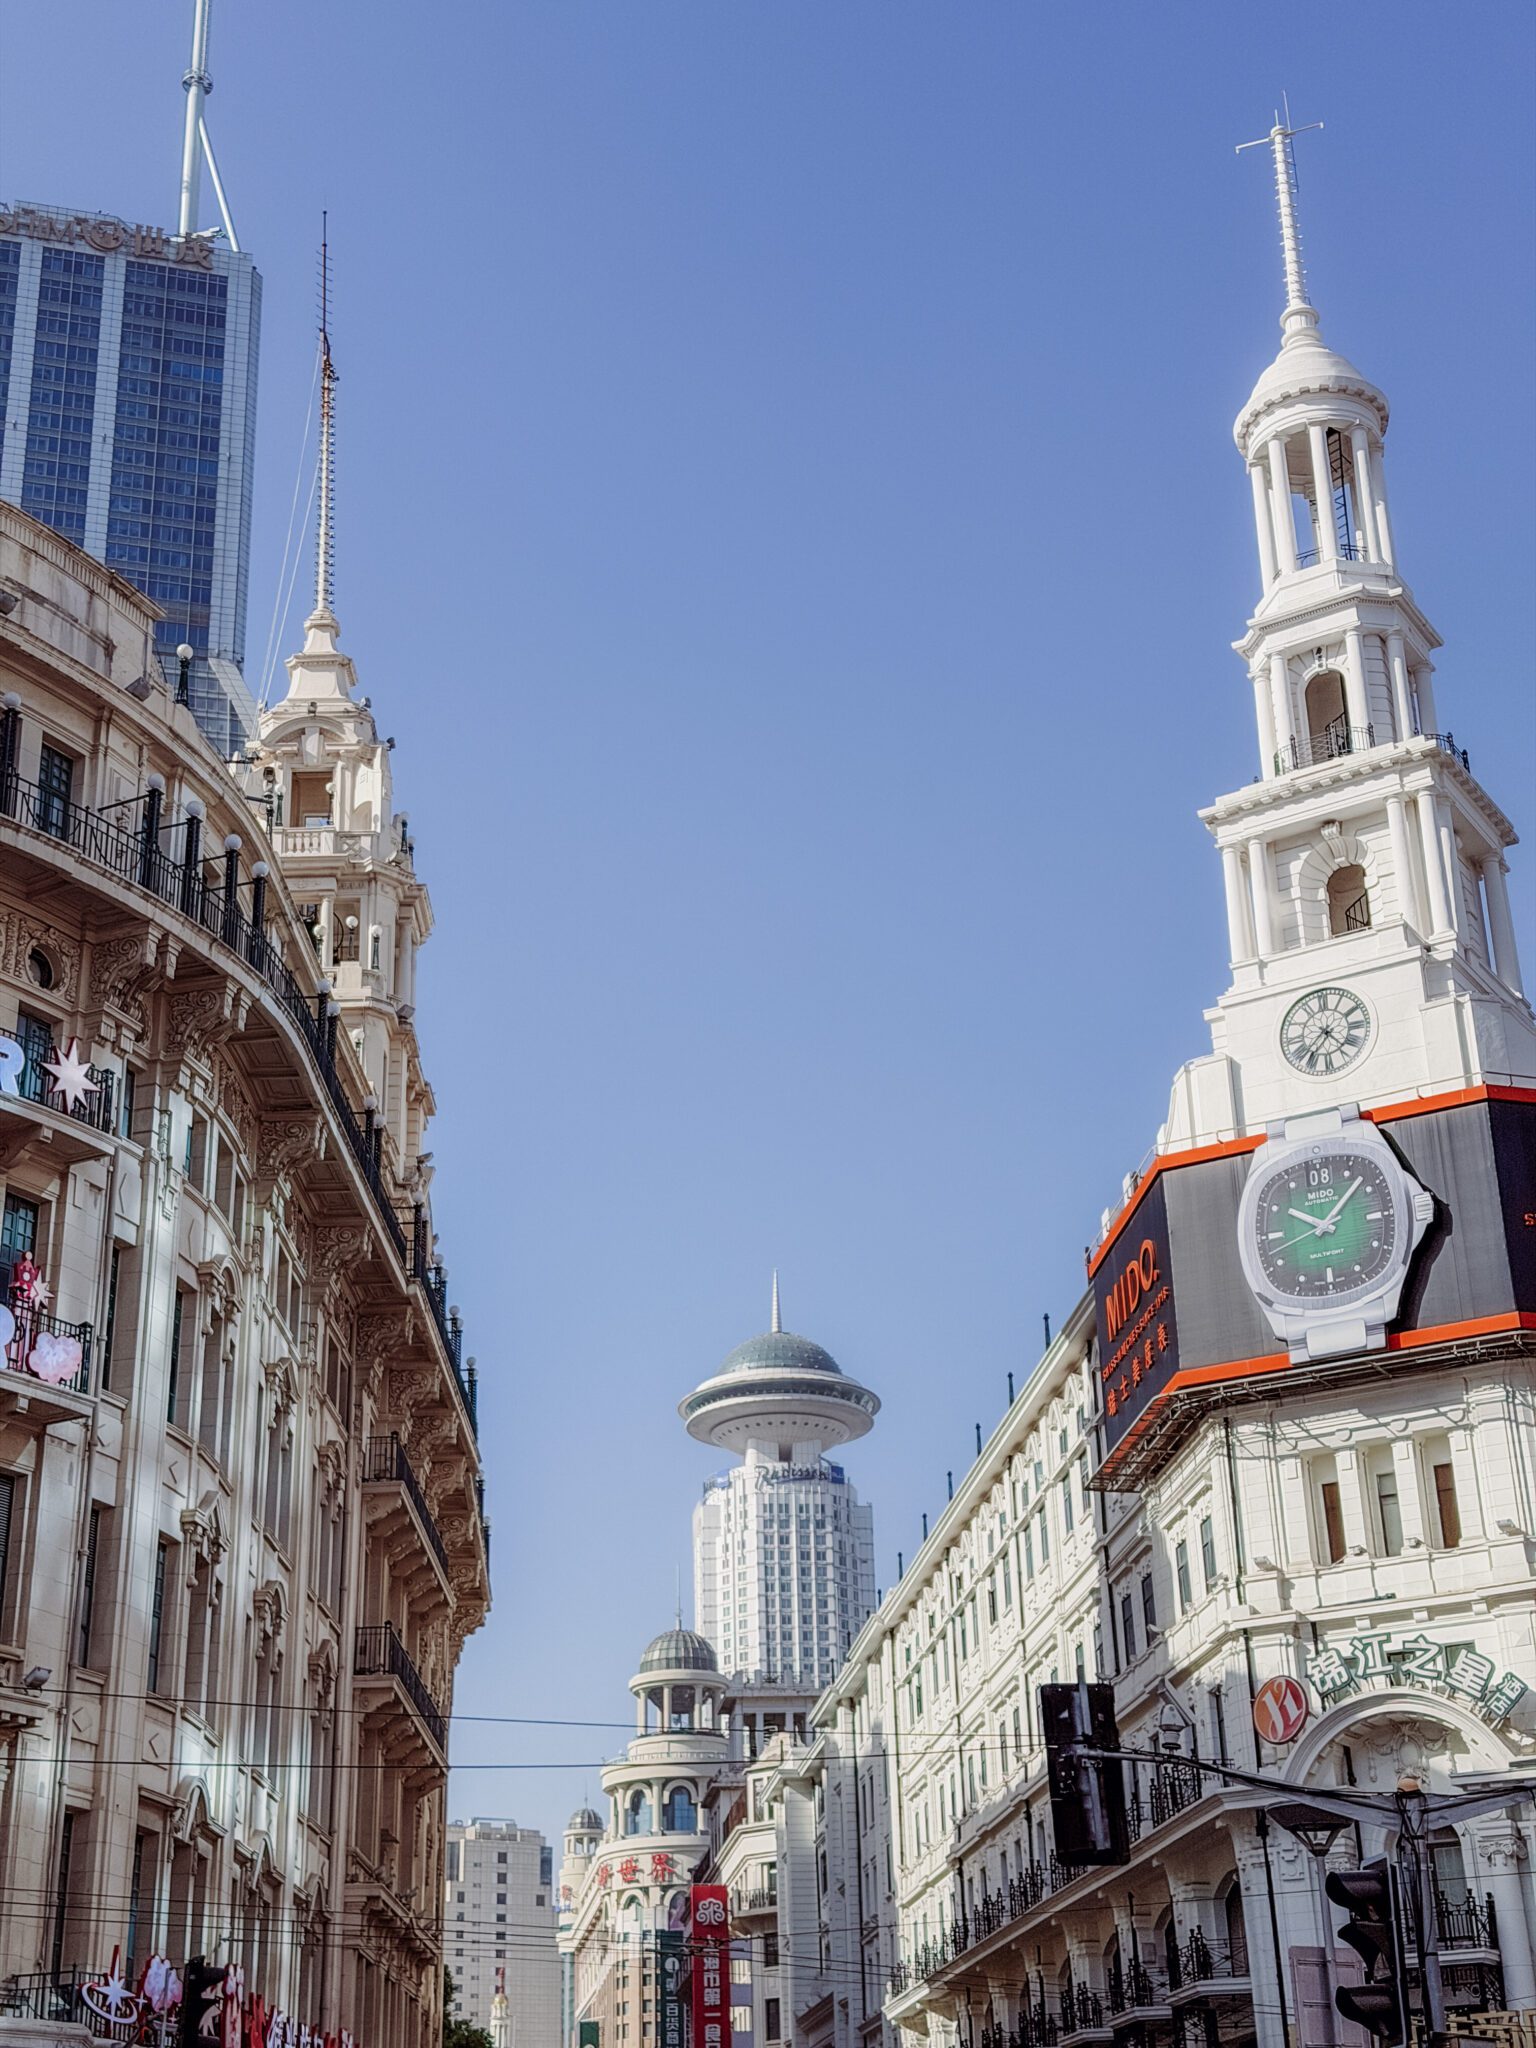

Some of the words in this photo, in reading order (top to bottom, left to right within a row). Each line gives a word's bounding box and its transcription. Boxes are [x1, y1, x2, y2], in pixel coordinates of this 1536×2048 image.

[133, 223, 214, 270] 世茂
[1307, 1188, 1334, 1200] MIDO
[1309, 1170, 1331, 1187] 08
[1304, 1195, 1339, 1207] AUTOMATIC
[1305, 1632, 1496, 1700] 锦江之星
[665, 1977, 680, 2048] 第一百货商
